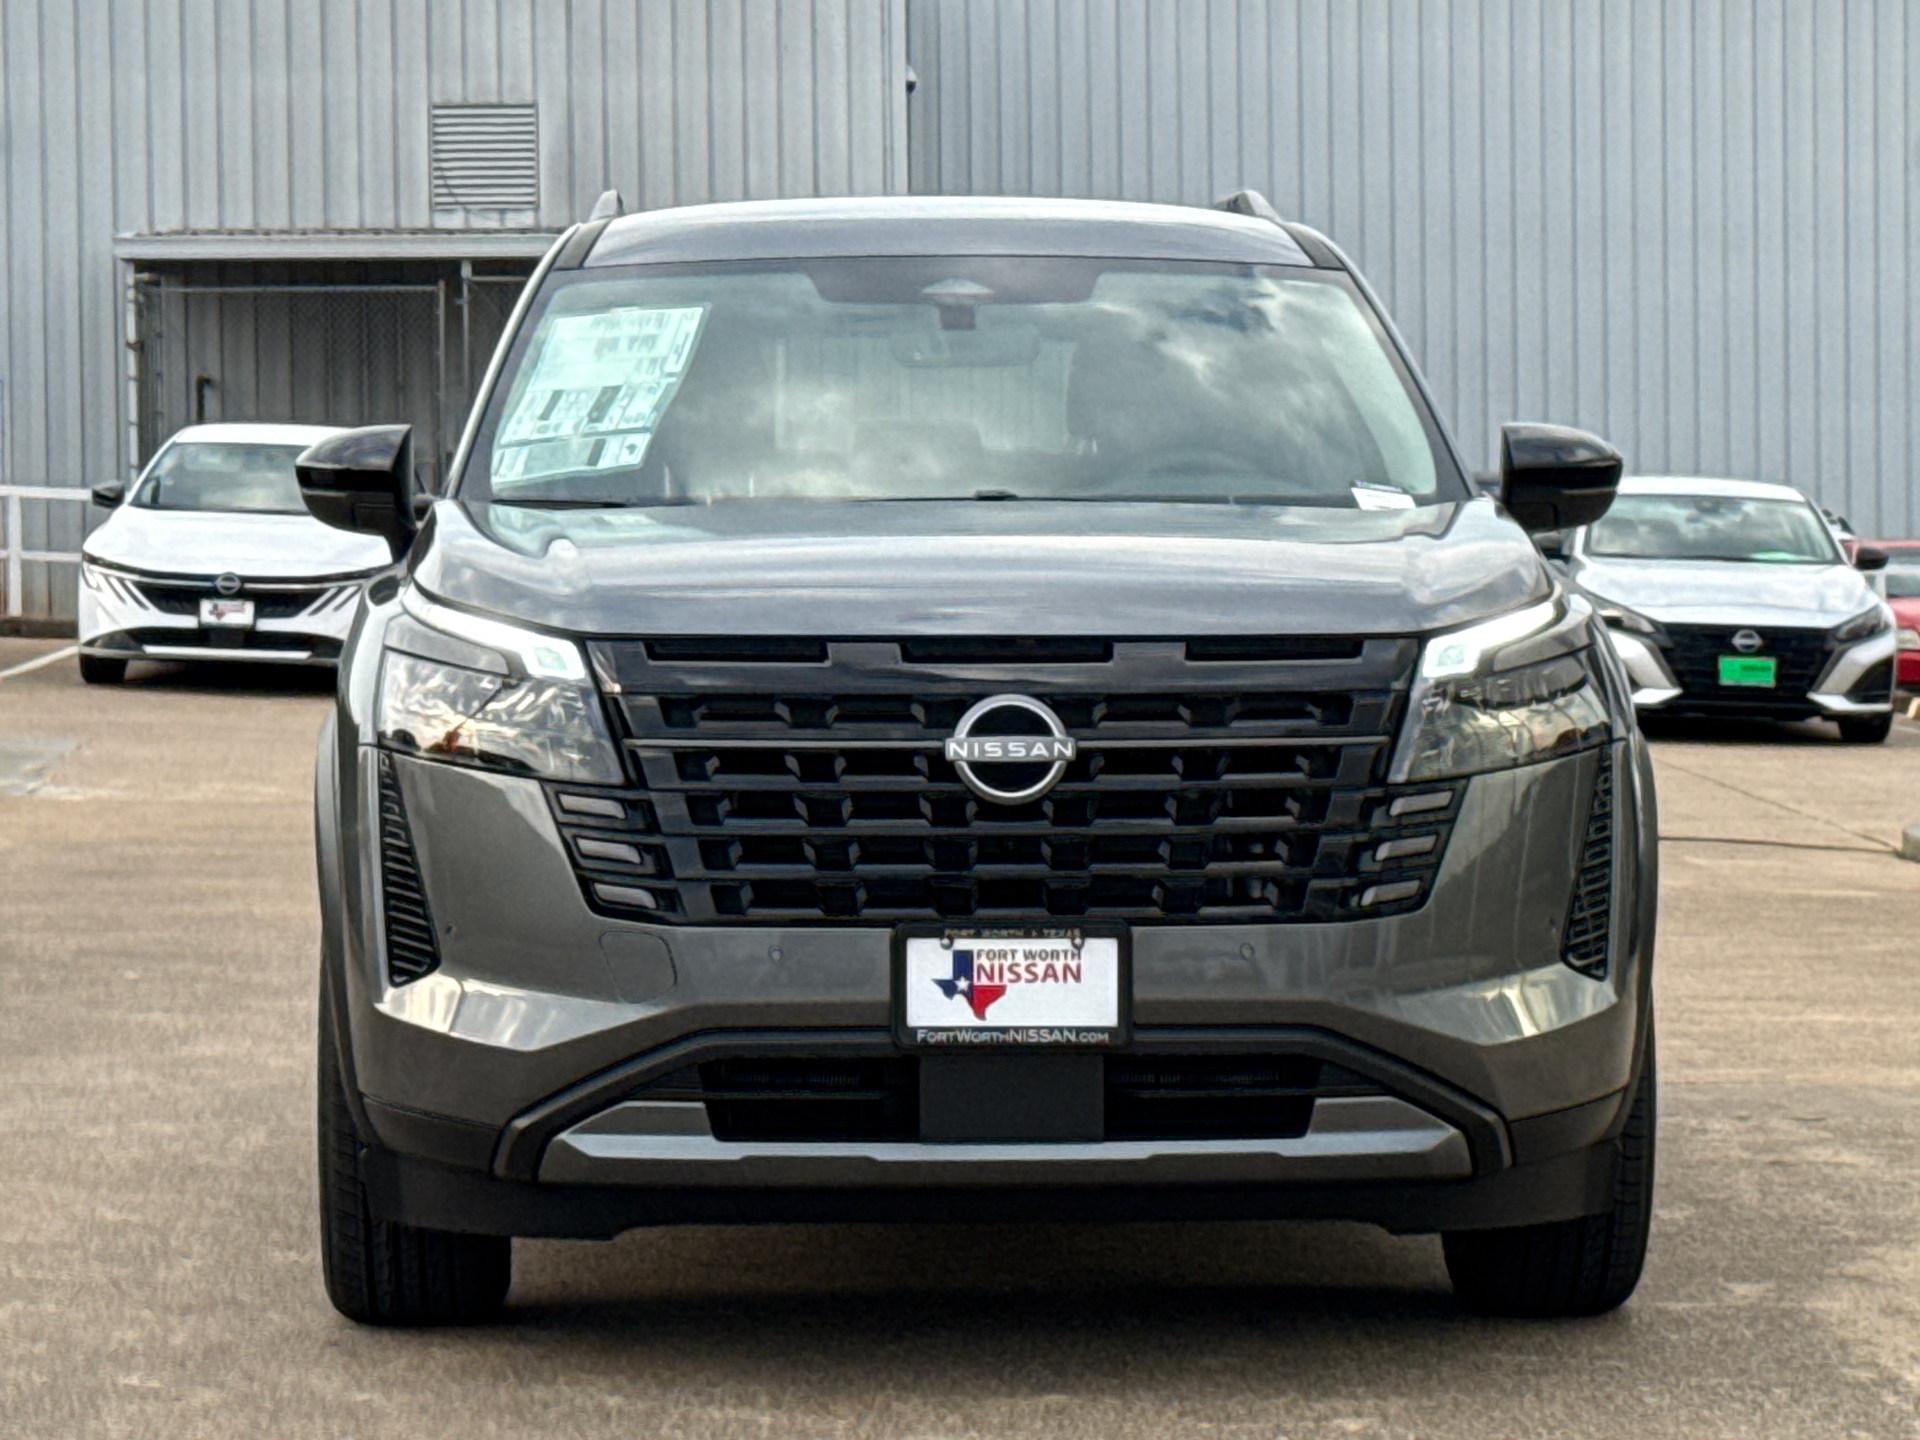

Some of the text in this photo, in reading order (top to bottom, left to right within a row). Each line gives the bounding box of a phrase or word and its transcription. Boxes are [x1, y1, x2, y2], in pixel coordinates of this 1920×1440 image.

[949, 741, 1073, 758] NISSAN
[976, 948, 1082, 962] FORT WORTH
[976, 962, 1082, 983] NISSAN
